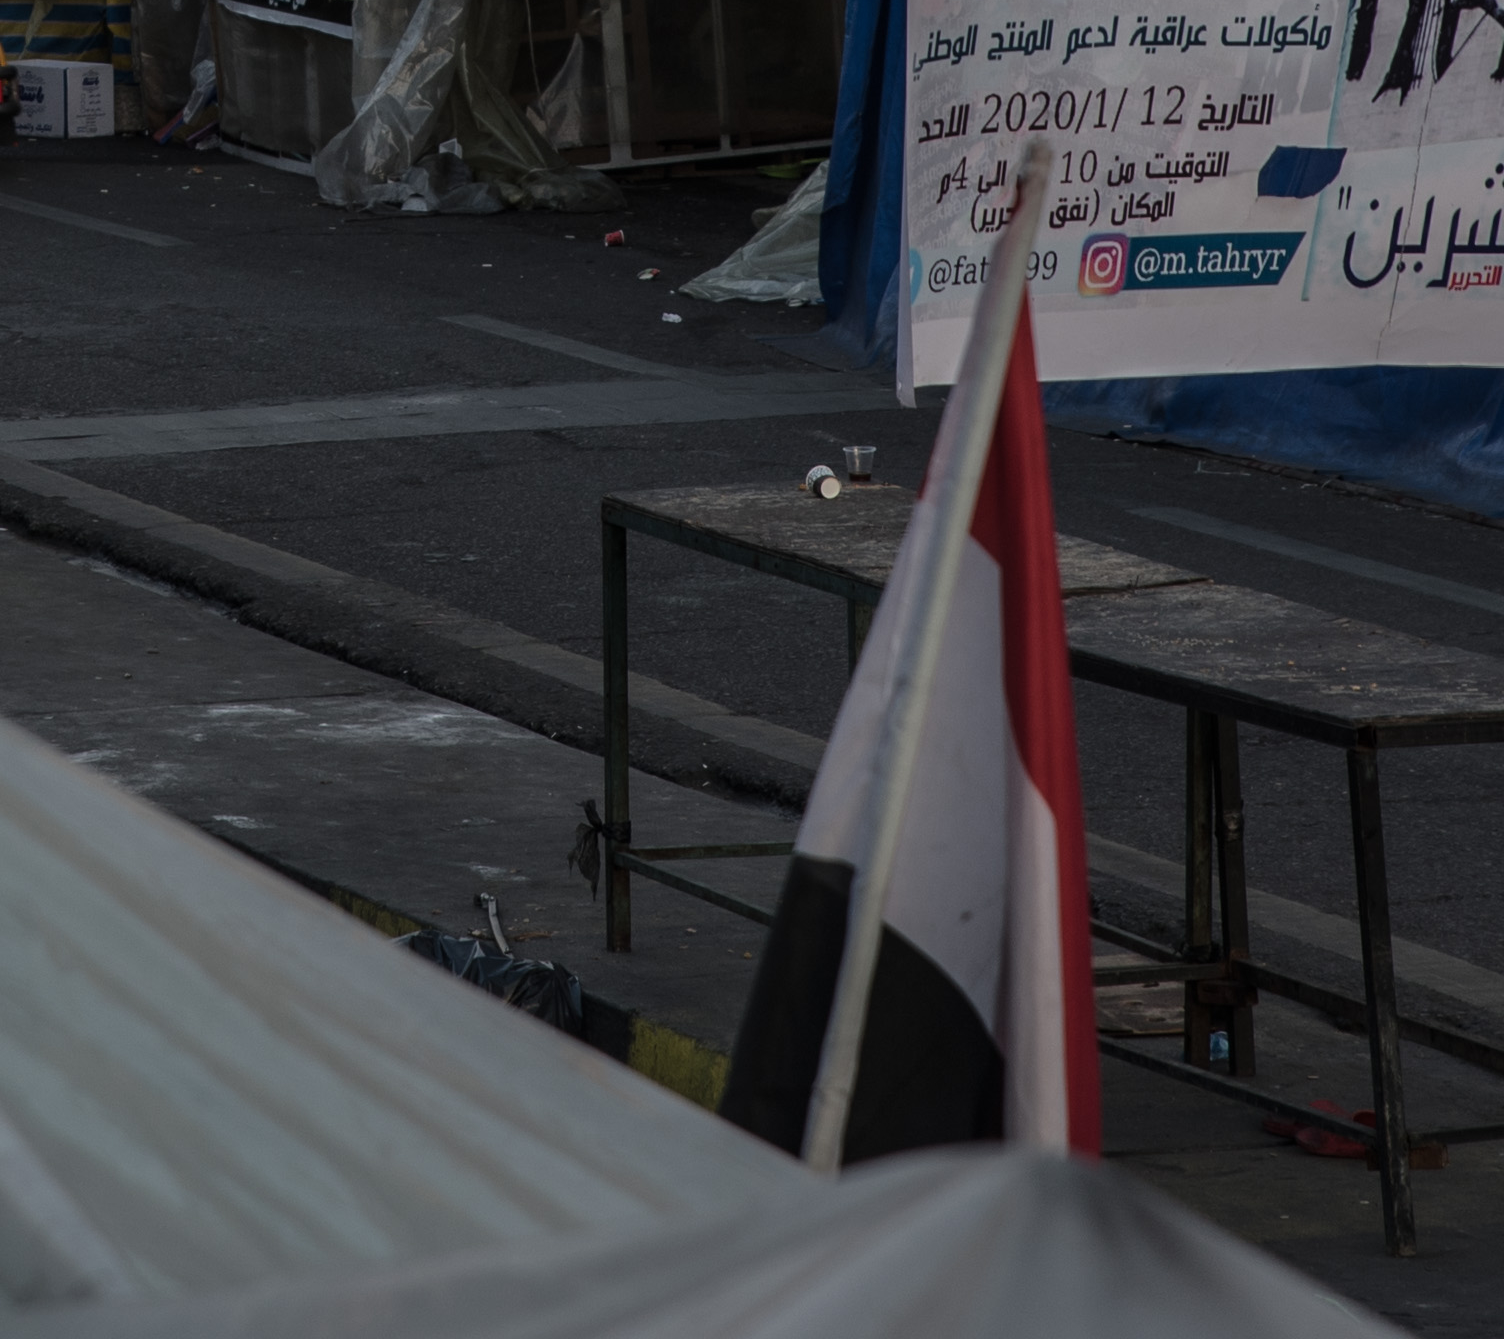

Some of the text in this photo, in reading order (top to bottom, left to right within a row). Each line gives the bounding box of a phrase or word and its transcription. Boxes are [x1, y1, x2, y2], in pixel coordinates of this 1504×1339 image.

[911, 2, 1333, 82] مأكولات عراقية لدعم المنتج الوطني
[1140, 84, 1187, 128] 12
[1197, 92, 1275, 132] التاريخ
[1059, 148, 1100, 186] 10
[1106, 155, 1136, 188] من
[1144, 151, 1230, 184] التوقيت
[1110, 190, 1176, 227] المكان
[1133, 242, 1287, 285] @m.tahryr
[1447, 264, 1502, 292] التحرير
